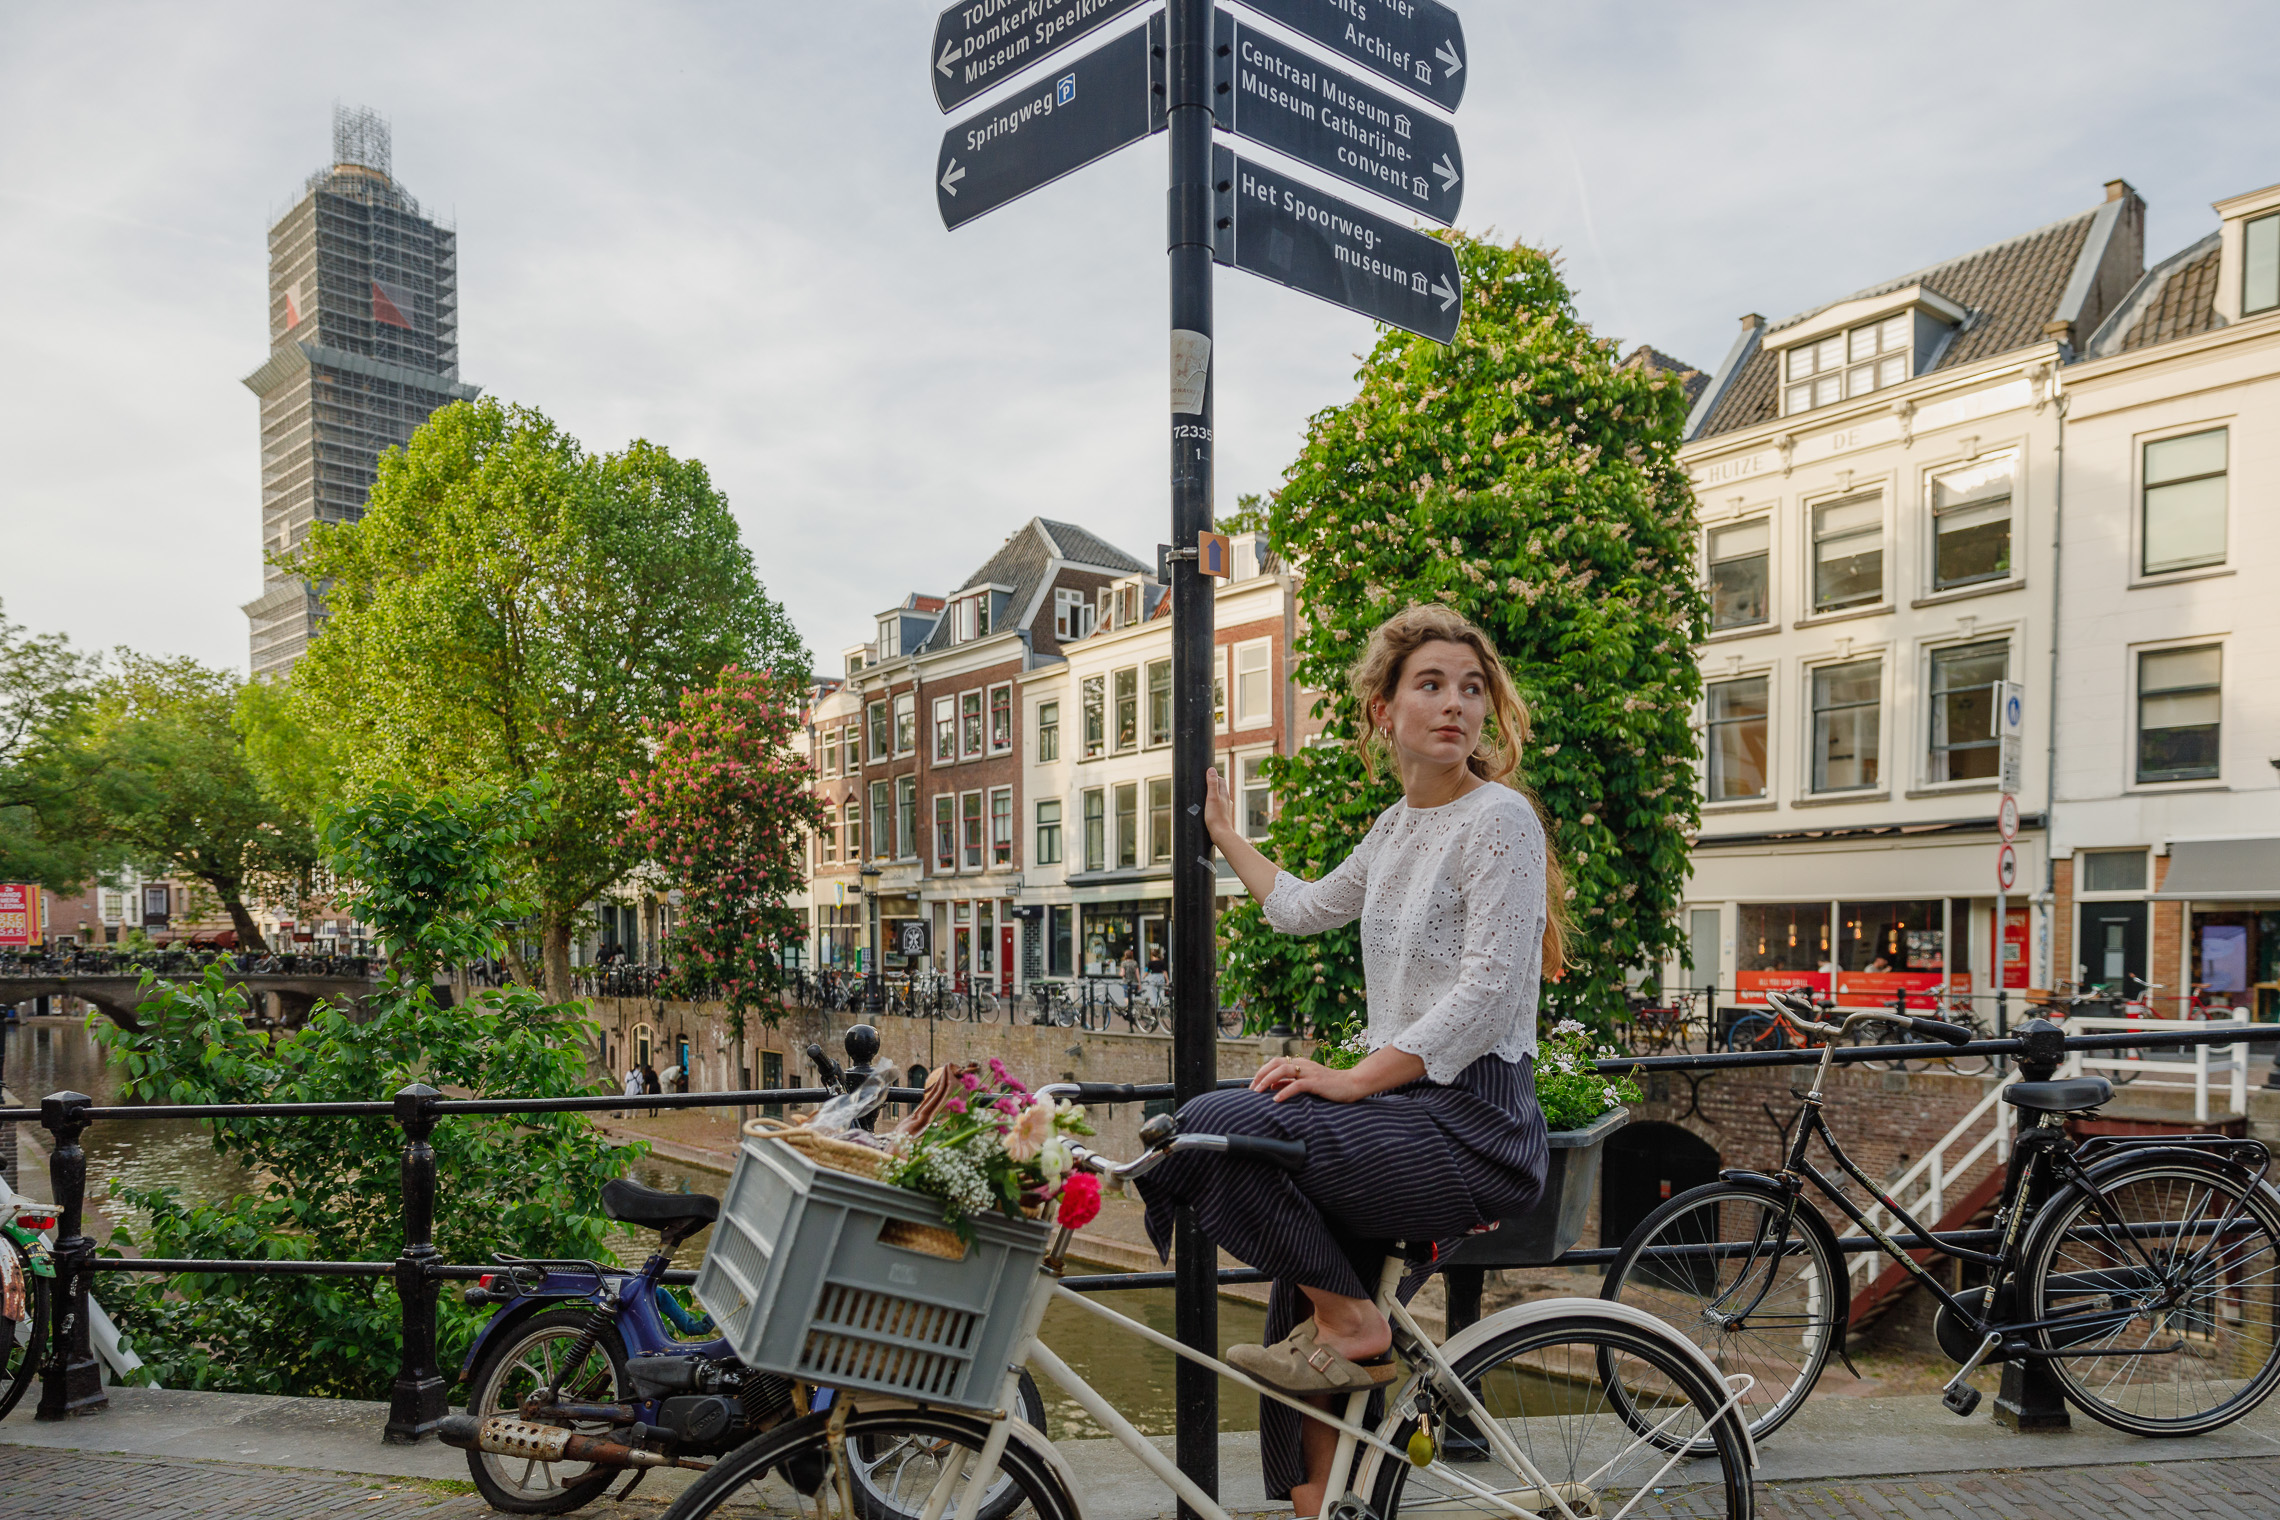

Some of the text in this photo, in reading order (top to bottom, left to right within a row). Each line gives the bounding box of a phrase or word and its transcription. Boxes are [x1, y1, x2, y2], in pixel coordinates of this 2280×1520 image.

[965, 35, 1030, 84] Museum
[1344, 23, 1411, 71] Archief
[1242, 41, 1390, 127] Centraal Museum
[967, 92, 1053, 151] Springweg
[1242, 69, 1412, 162] Museum Catharijne-
[1337, 146, 1408, 190] convent
[1242, 172, 1382, 250] Het Spoorweg-
[1334, 244, 1407, 286] museum
[1173, 424, 1212, 442] 72335
[1196, 448, 1201, 460] 1
[1709, 429, 1861, 483] HUIZE DE
[2006, 1184, 2031, 1246] BATAVUS
[1858, 1216, 1922, 1275] BATAVUS
